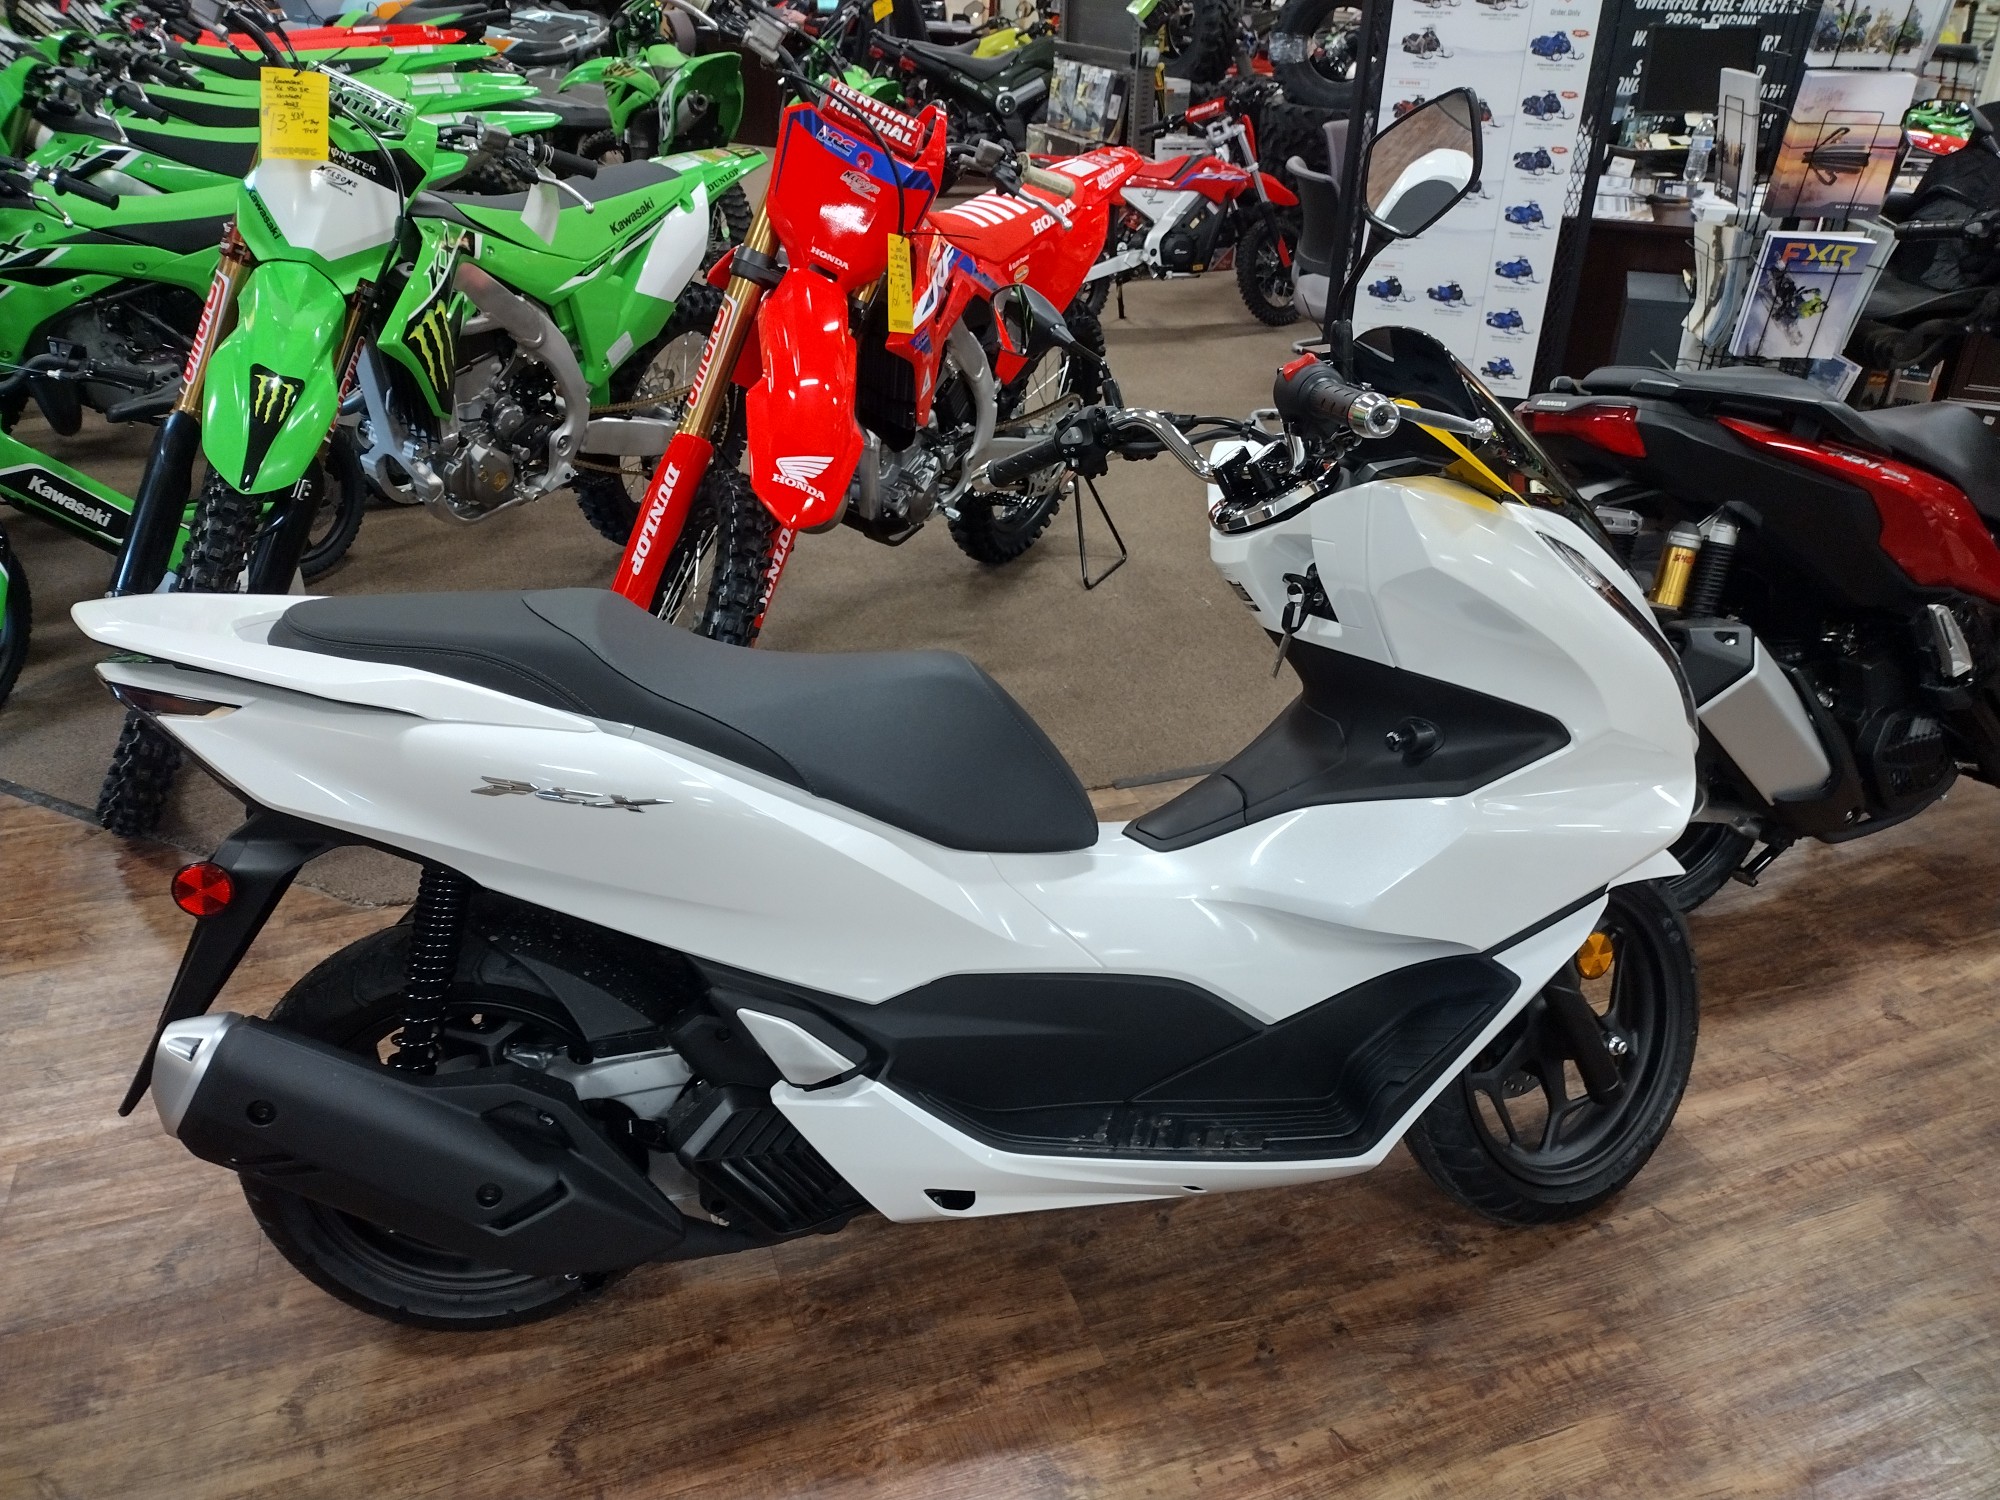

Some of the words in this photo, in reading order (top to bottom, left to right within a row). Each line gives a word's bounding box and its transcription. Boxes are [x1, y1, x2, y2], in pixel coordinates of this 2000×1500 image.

[833, 83, 918, 132] RENTHAL
[707, 167, 740, 193] DUNLOP
[609, 197, 656, 236] Kawasaki
[810, 246, 849, 270] HONDA
[1781, 242, 1858, 268] FXR
[27, 475, 113, 527] Kawasaki
[772, 473, 826, 502] HONDA
[631, 461, 681, 576] DUNLOP
[470, 775, 675, 813] PCX
